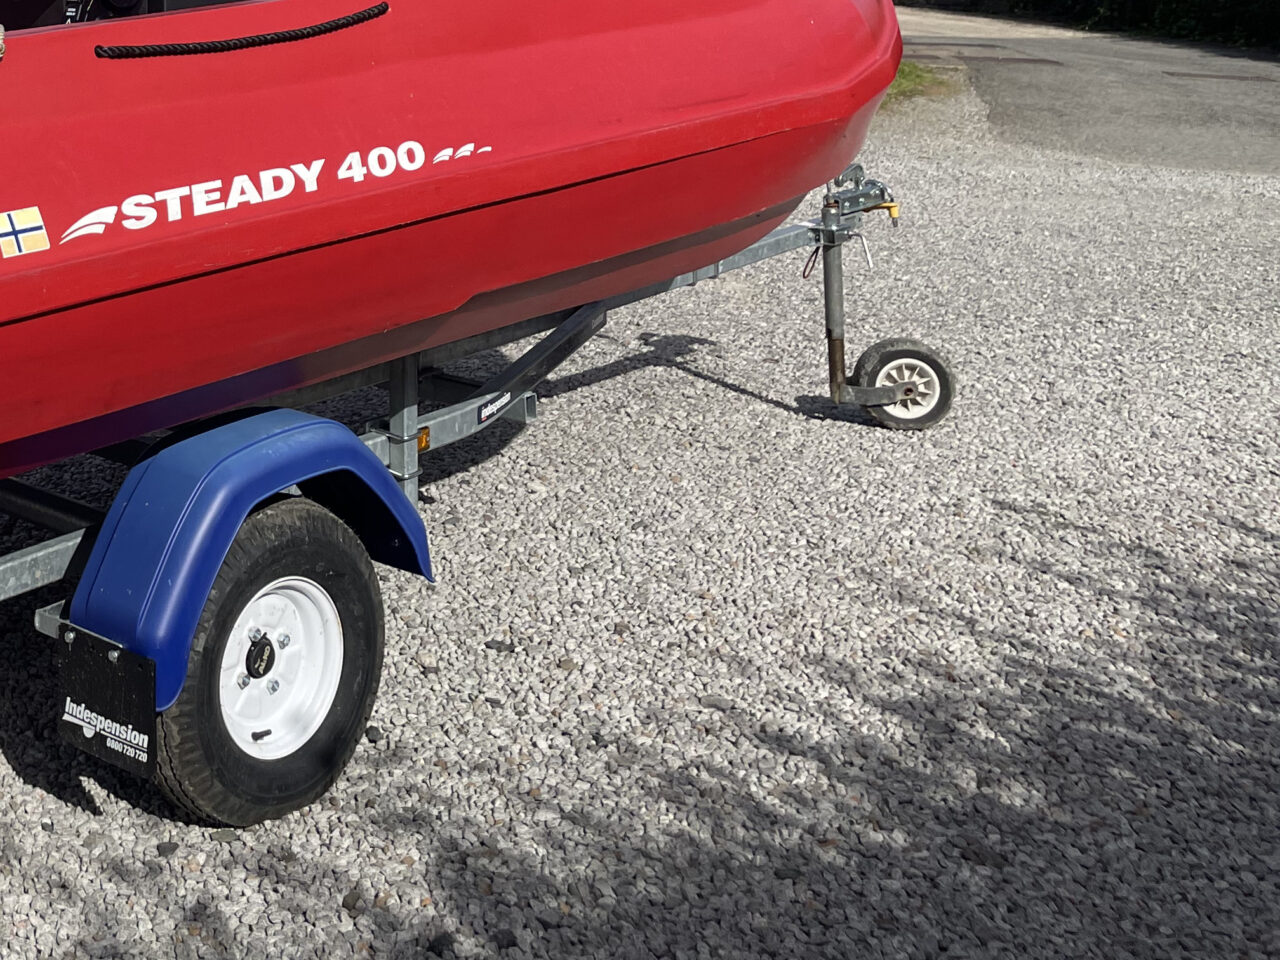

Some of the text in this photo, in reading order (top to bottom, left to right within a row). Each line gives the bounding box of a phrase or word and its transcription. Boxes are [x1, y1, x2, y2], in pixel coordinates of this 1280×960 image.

[120, 140, 426, 230] STEADY 400
[65, 696, 149, 748] Indespension
[106, 737, 148, 763] 0800 720 720
